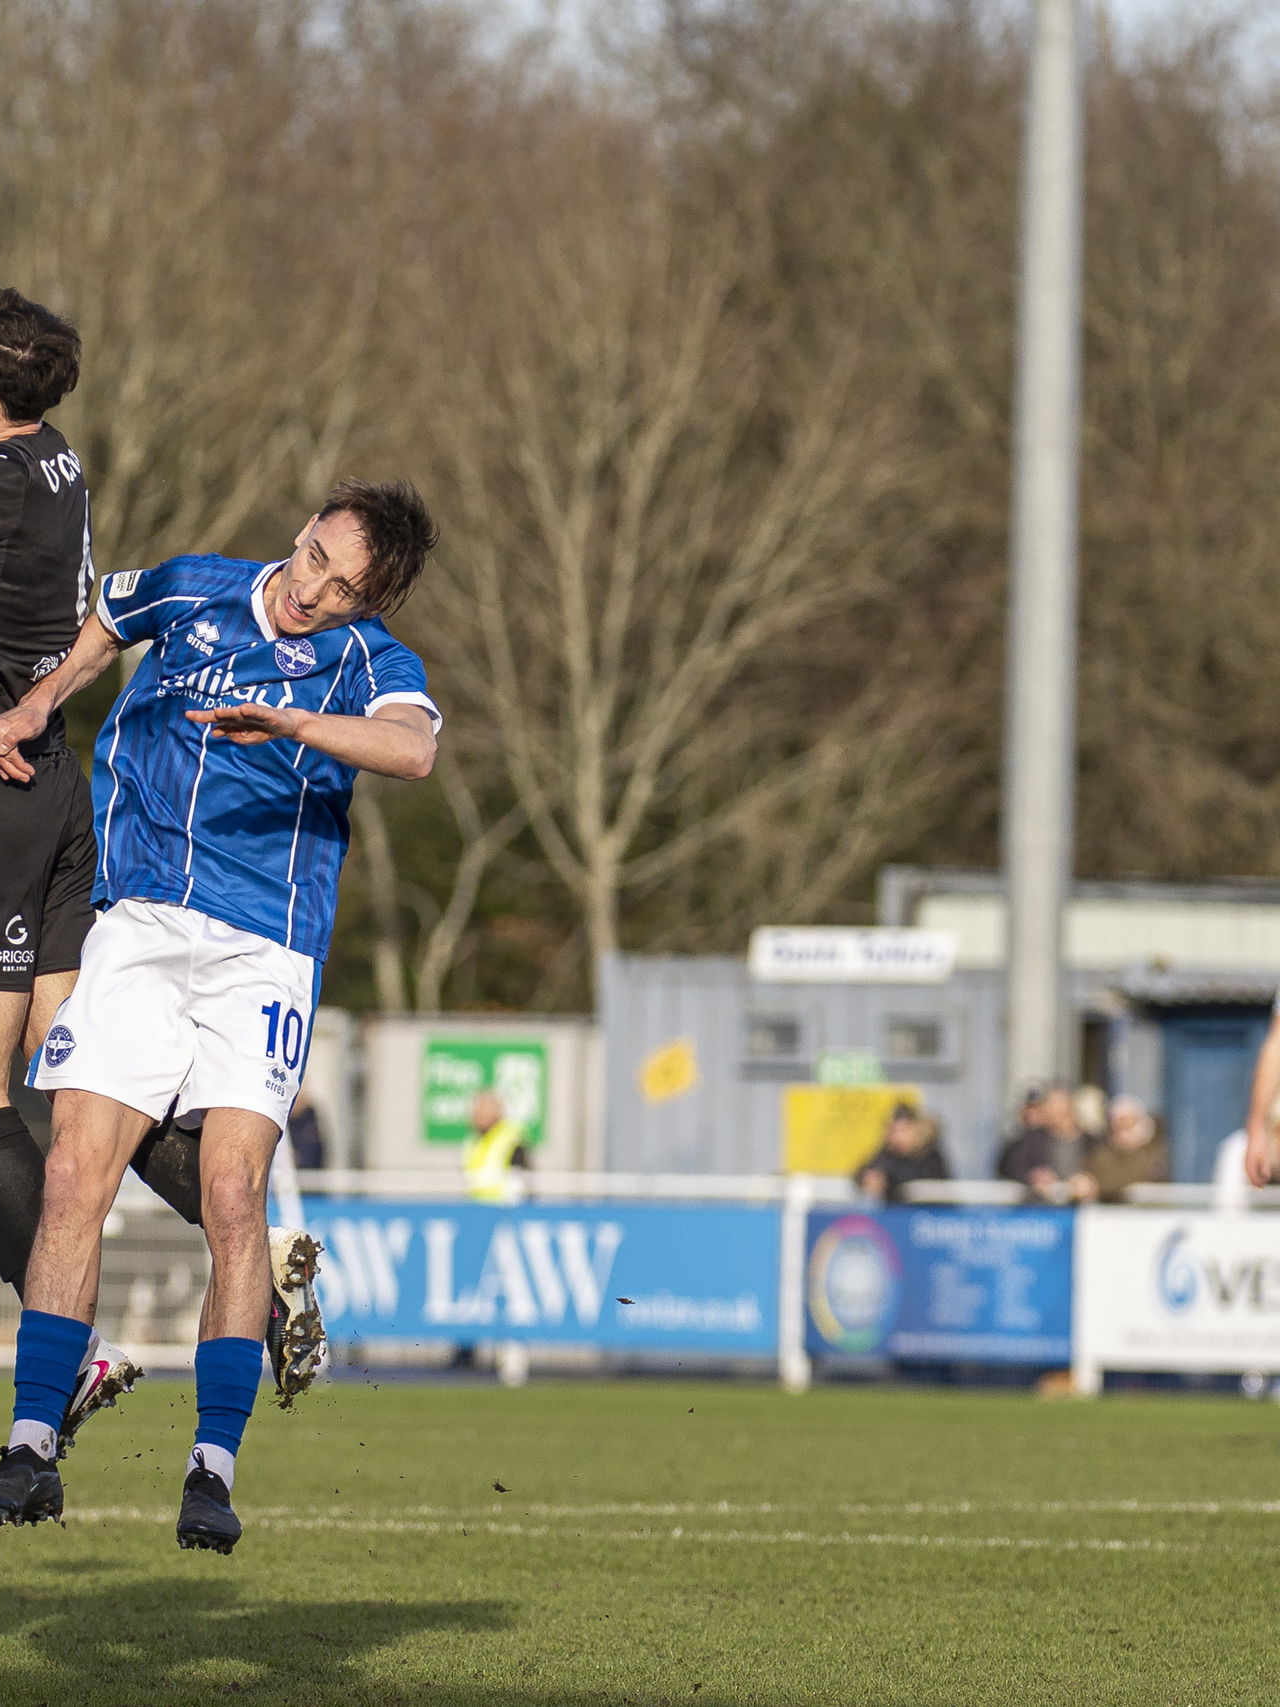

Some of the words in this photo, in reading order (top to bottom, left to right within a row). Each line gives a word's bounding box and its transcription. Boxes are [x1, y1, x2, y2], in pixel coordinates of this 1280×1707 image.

[186, 633, 214, 657] errea
[261, 1000, 303, 1070] 10
[265, 1079, 285, 1097] errea
[422, 1217, 624, 1328] LAW
